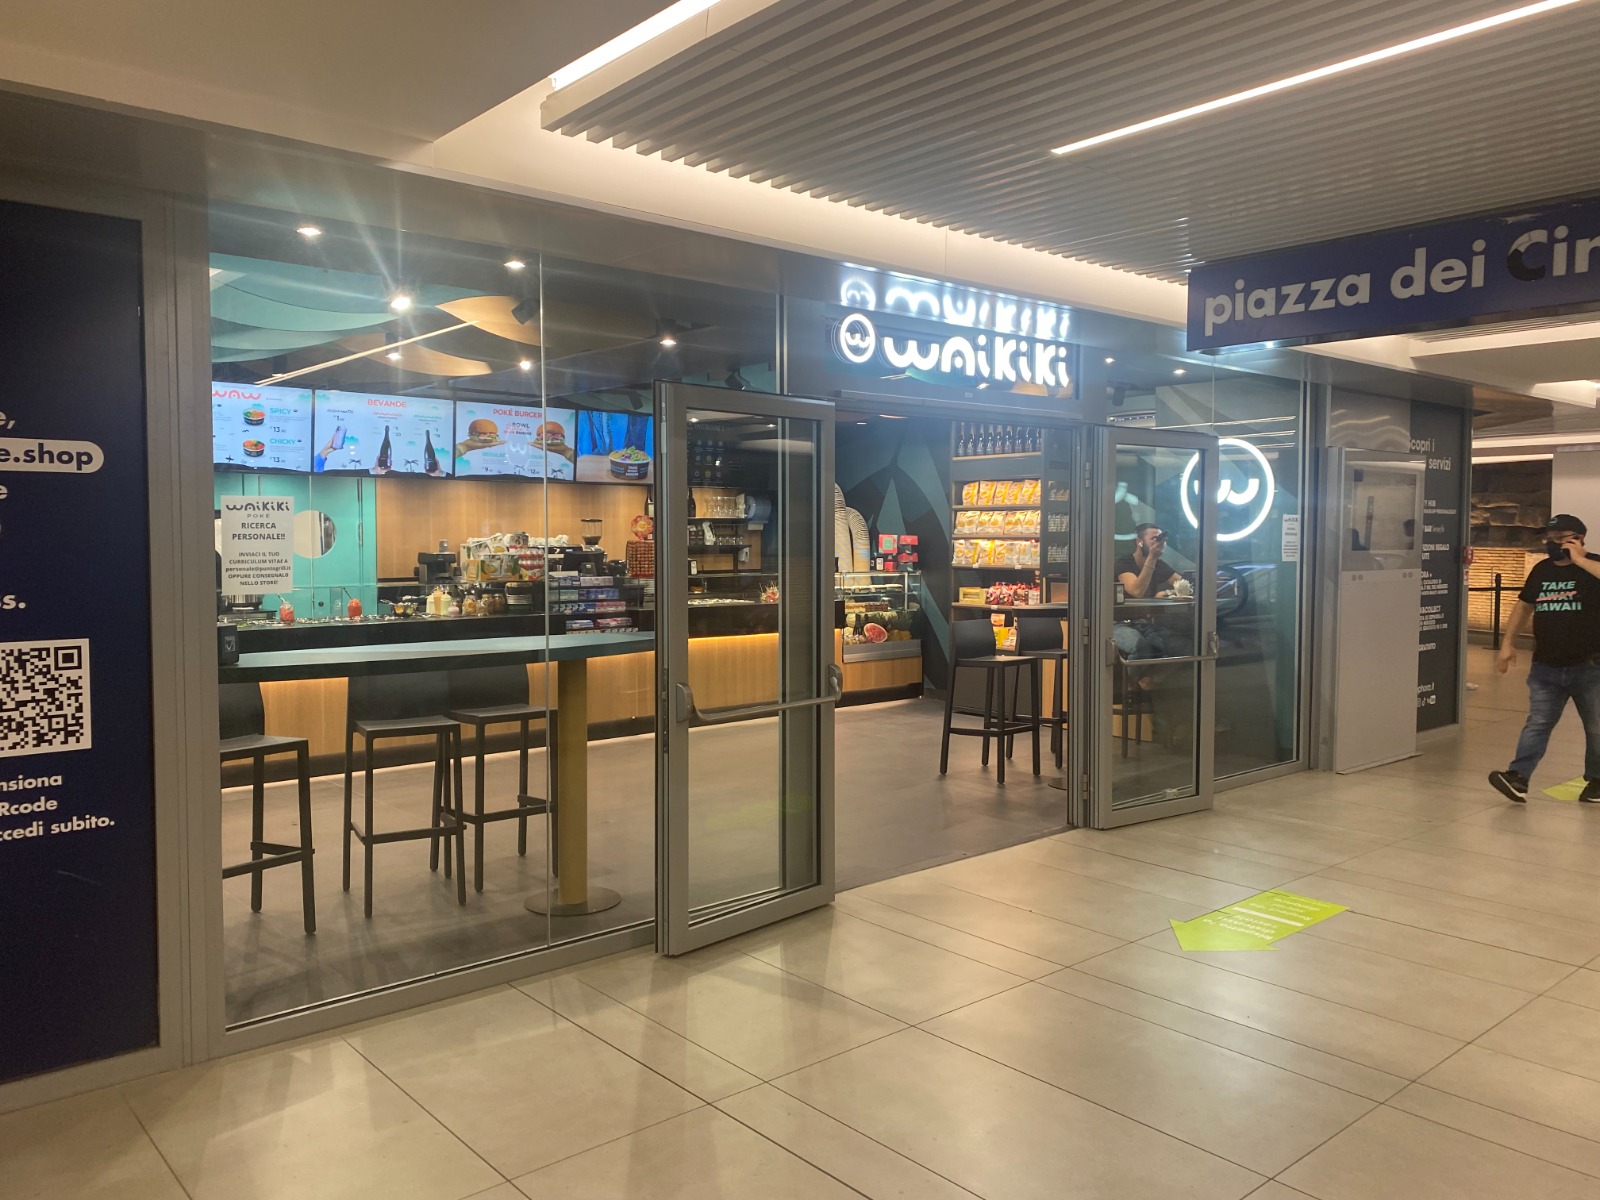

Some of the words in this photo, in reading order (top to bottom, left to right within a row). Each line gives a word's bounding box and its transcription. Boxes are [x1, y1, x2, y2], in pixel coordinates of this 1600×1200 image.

[1204, 278, 1371, 336] piazza
[1390, 239, 1486, 310] dei
[883, 335, 1070, 388] waikiki
[367, 399, 407, 408] BEVANDE
[514, 410, 543, 419] BURGER
[1409, 438, 1431, 453] copri
[1431, 438, 1436, 452] i
[1428, 456, 1452, 471] servizi
[1541, 581, 1577, 590] TAKE
[51, 815, 115, 834] subito.
